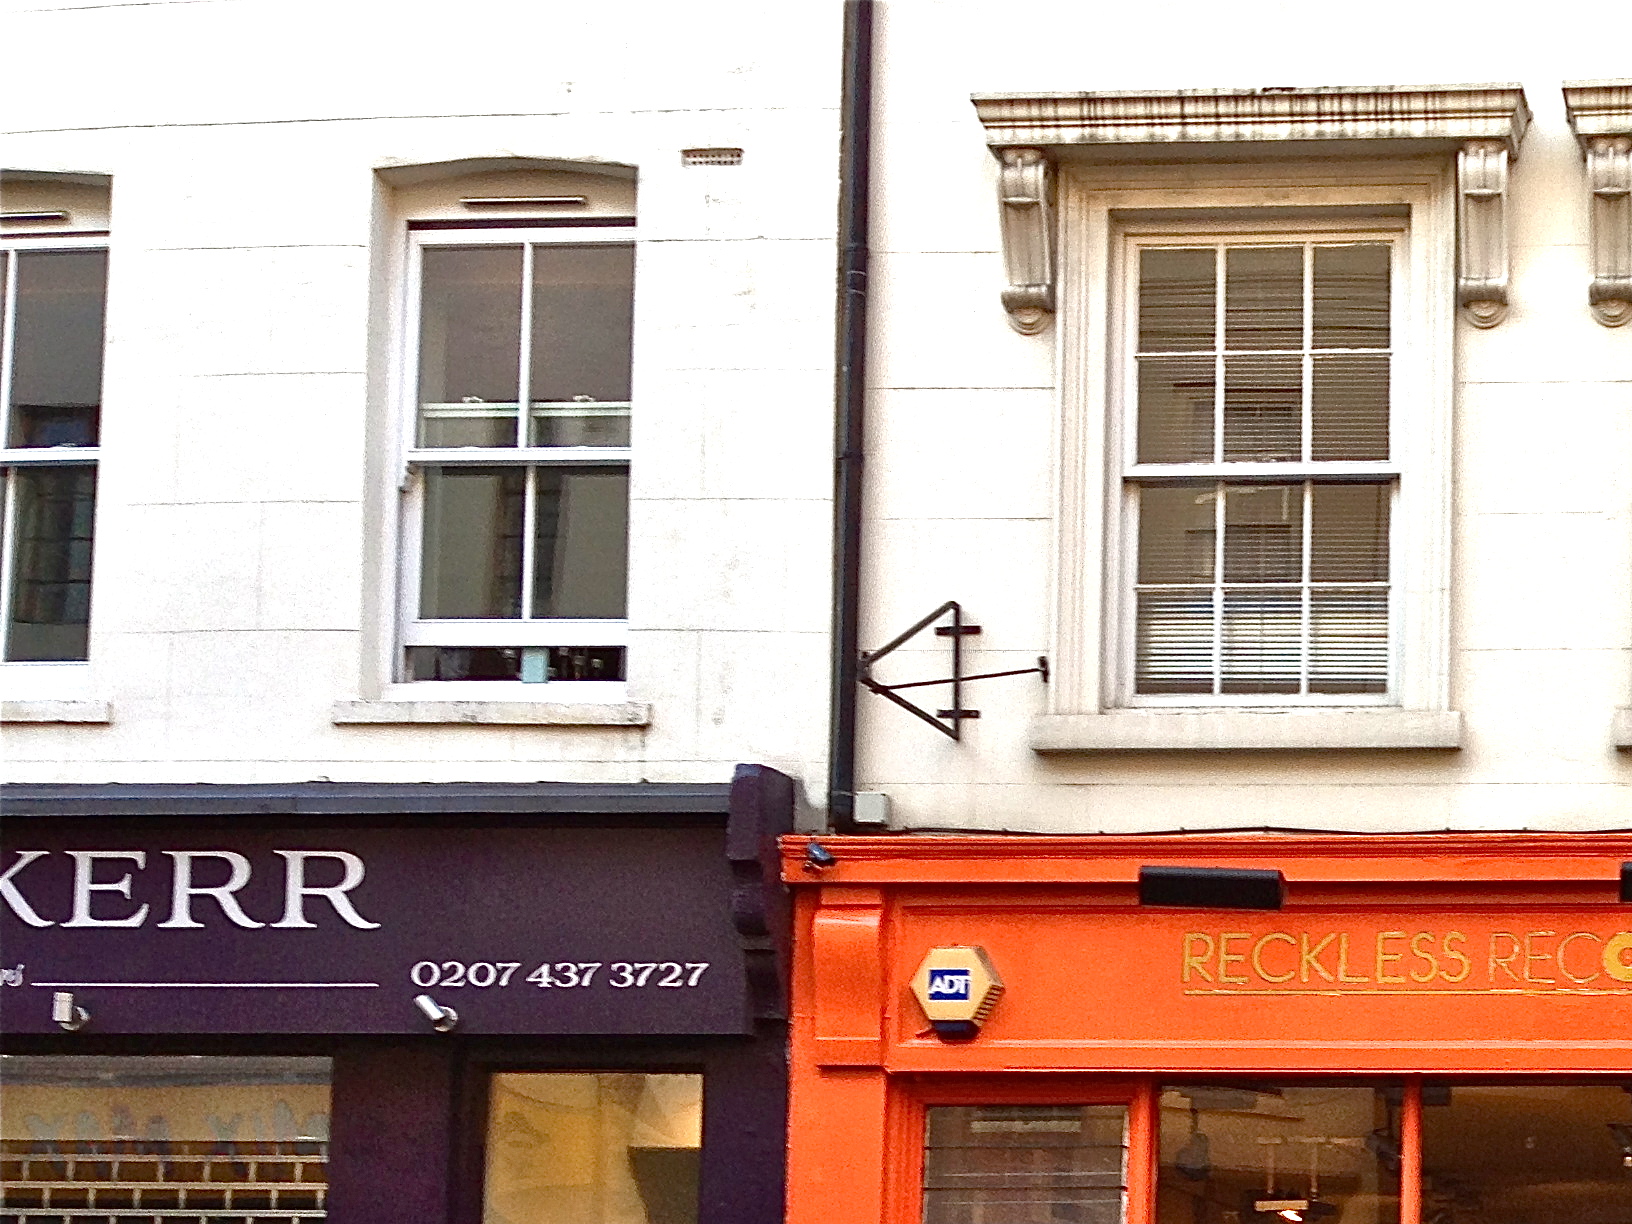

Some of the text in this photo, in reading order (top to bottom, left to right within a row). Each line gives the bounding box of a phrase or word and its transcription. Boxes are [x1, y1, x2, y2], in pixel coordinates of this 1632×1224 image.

[0, 849, 382, 929] KERR
[410, 960, 710, 988] 0207 437 3727
[1182, 931, 1472, 984] RECKLESS
[927, 974, 972, 995] ADT
